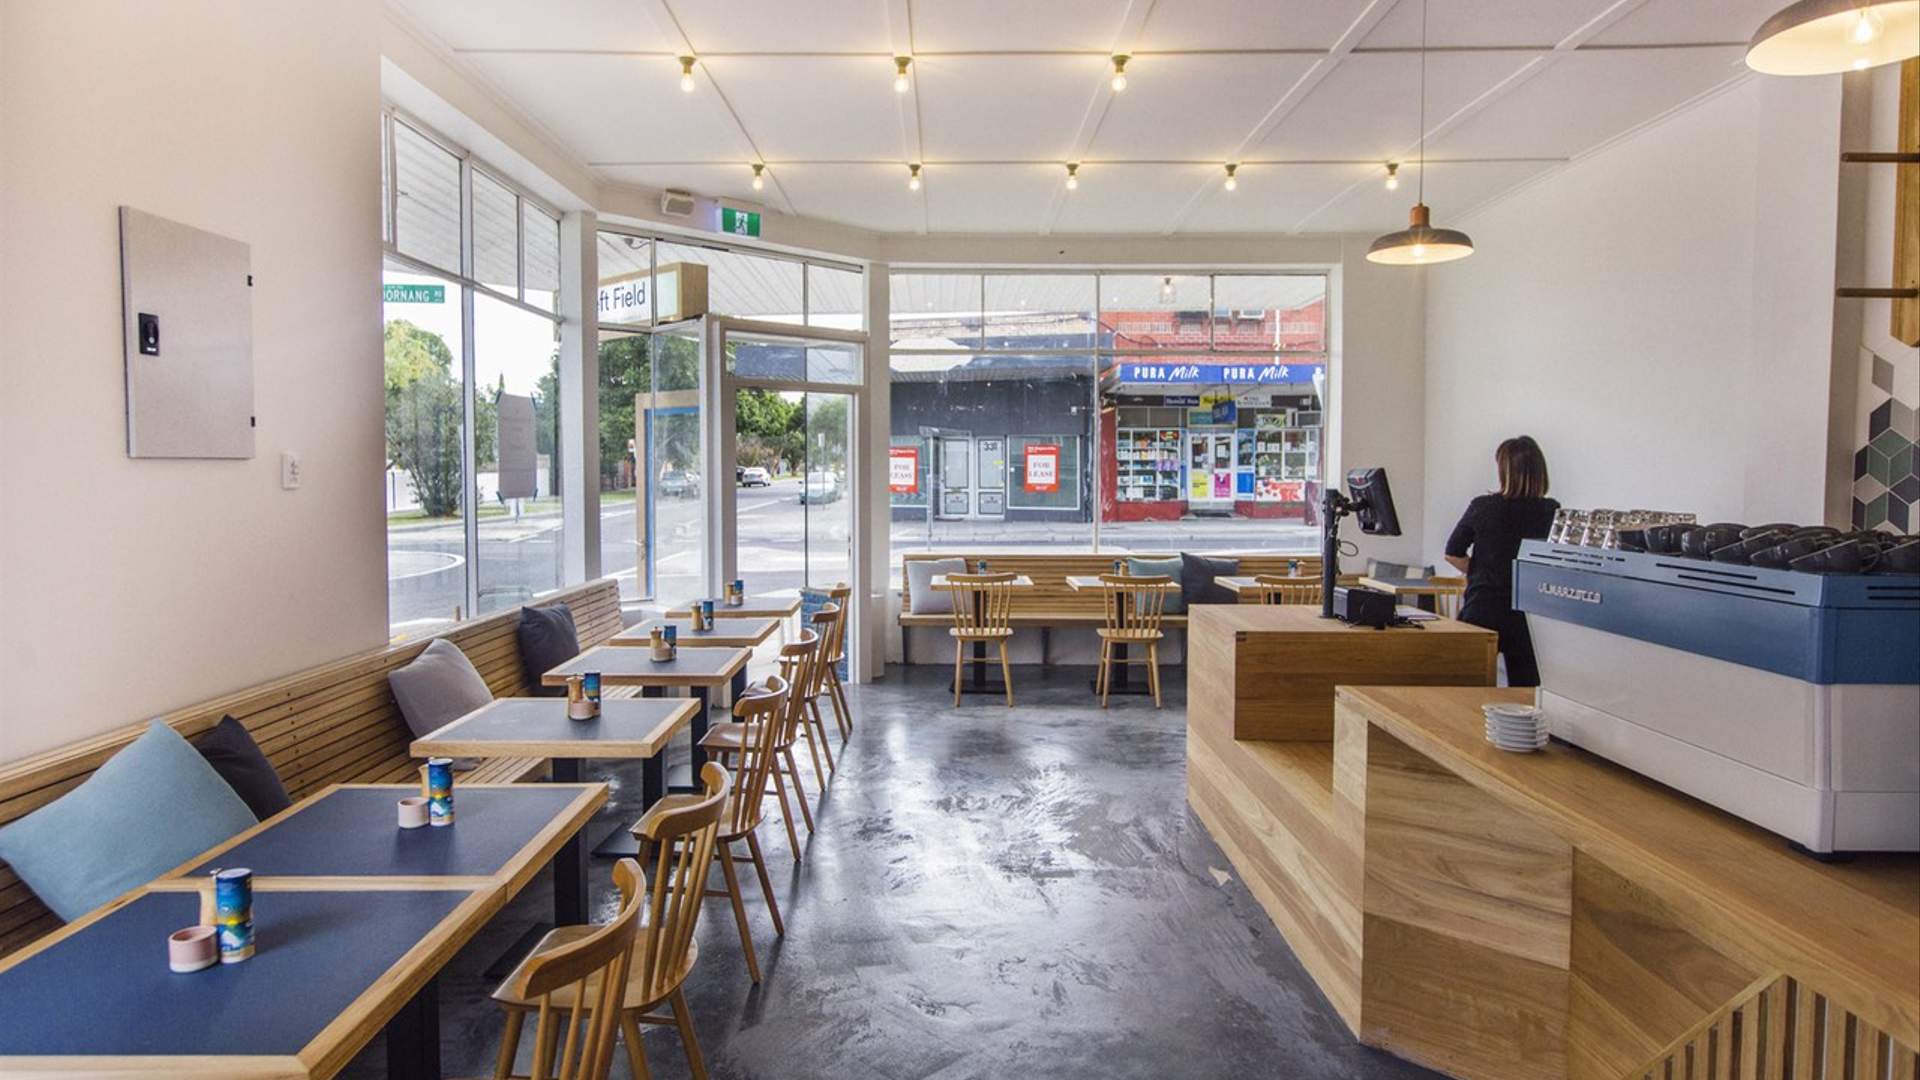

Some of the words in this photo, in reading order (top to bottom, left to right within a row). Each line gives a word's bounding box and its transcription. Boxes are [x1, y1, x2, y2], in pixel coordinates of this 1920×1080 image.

[384, 290, 430, 302] ORNANG
[597, 290, 609, 312] ft
[613, 281, 645, 309] Field
[1134, 367, 1165, 379] PURA
[1168, 365, 1199, 381] Milk
[1223, 367, 1255, 379] PURA
[1257, 365, 1289, 381] Milk
